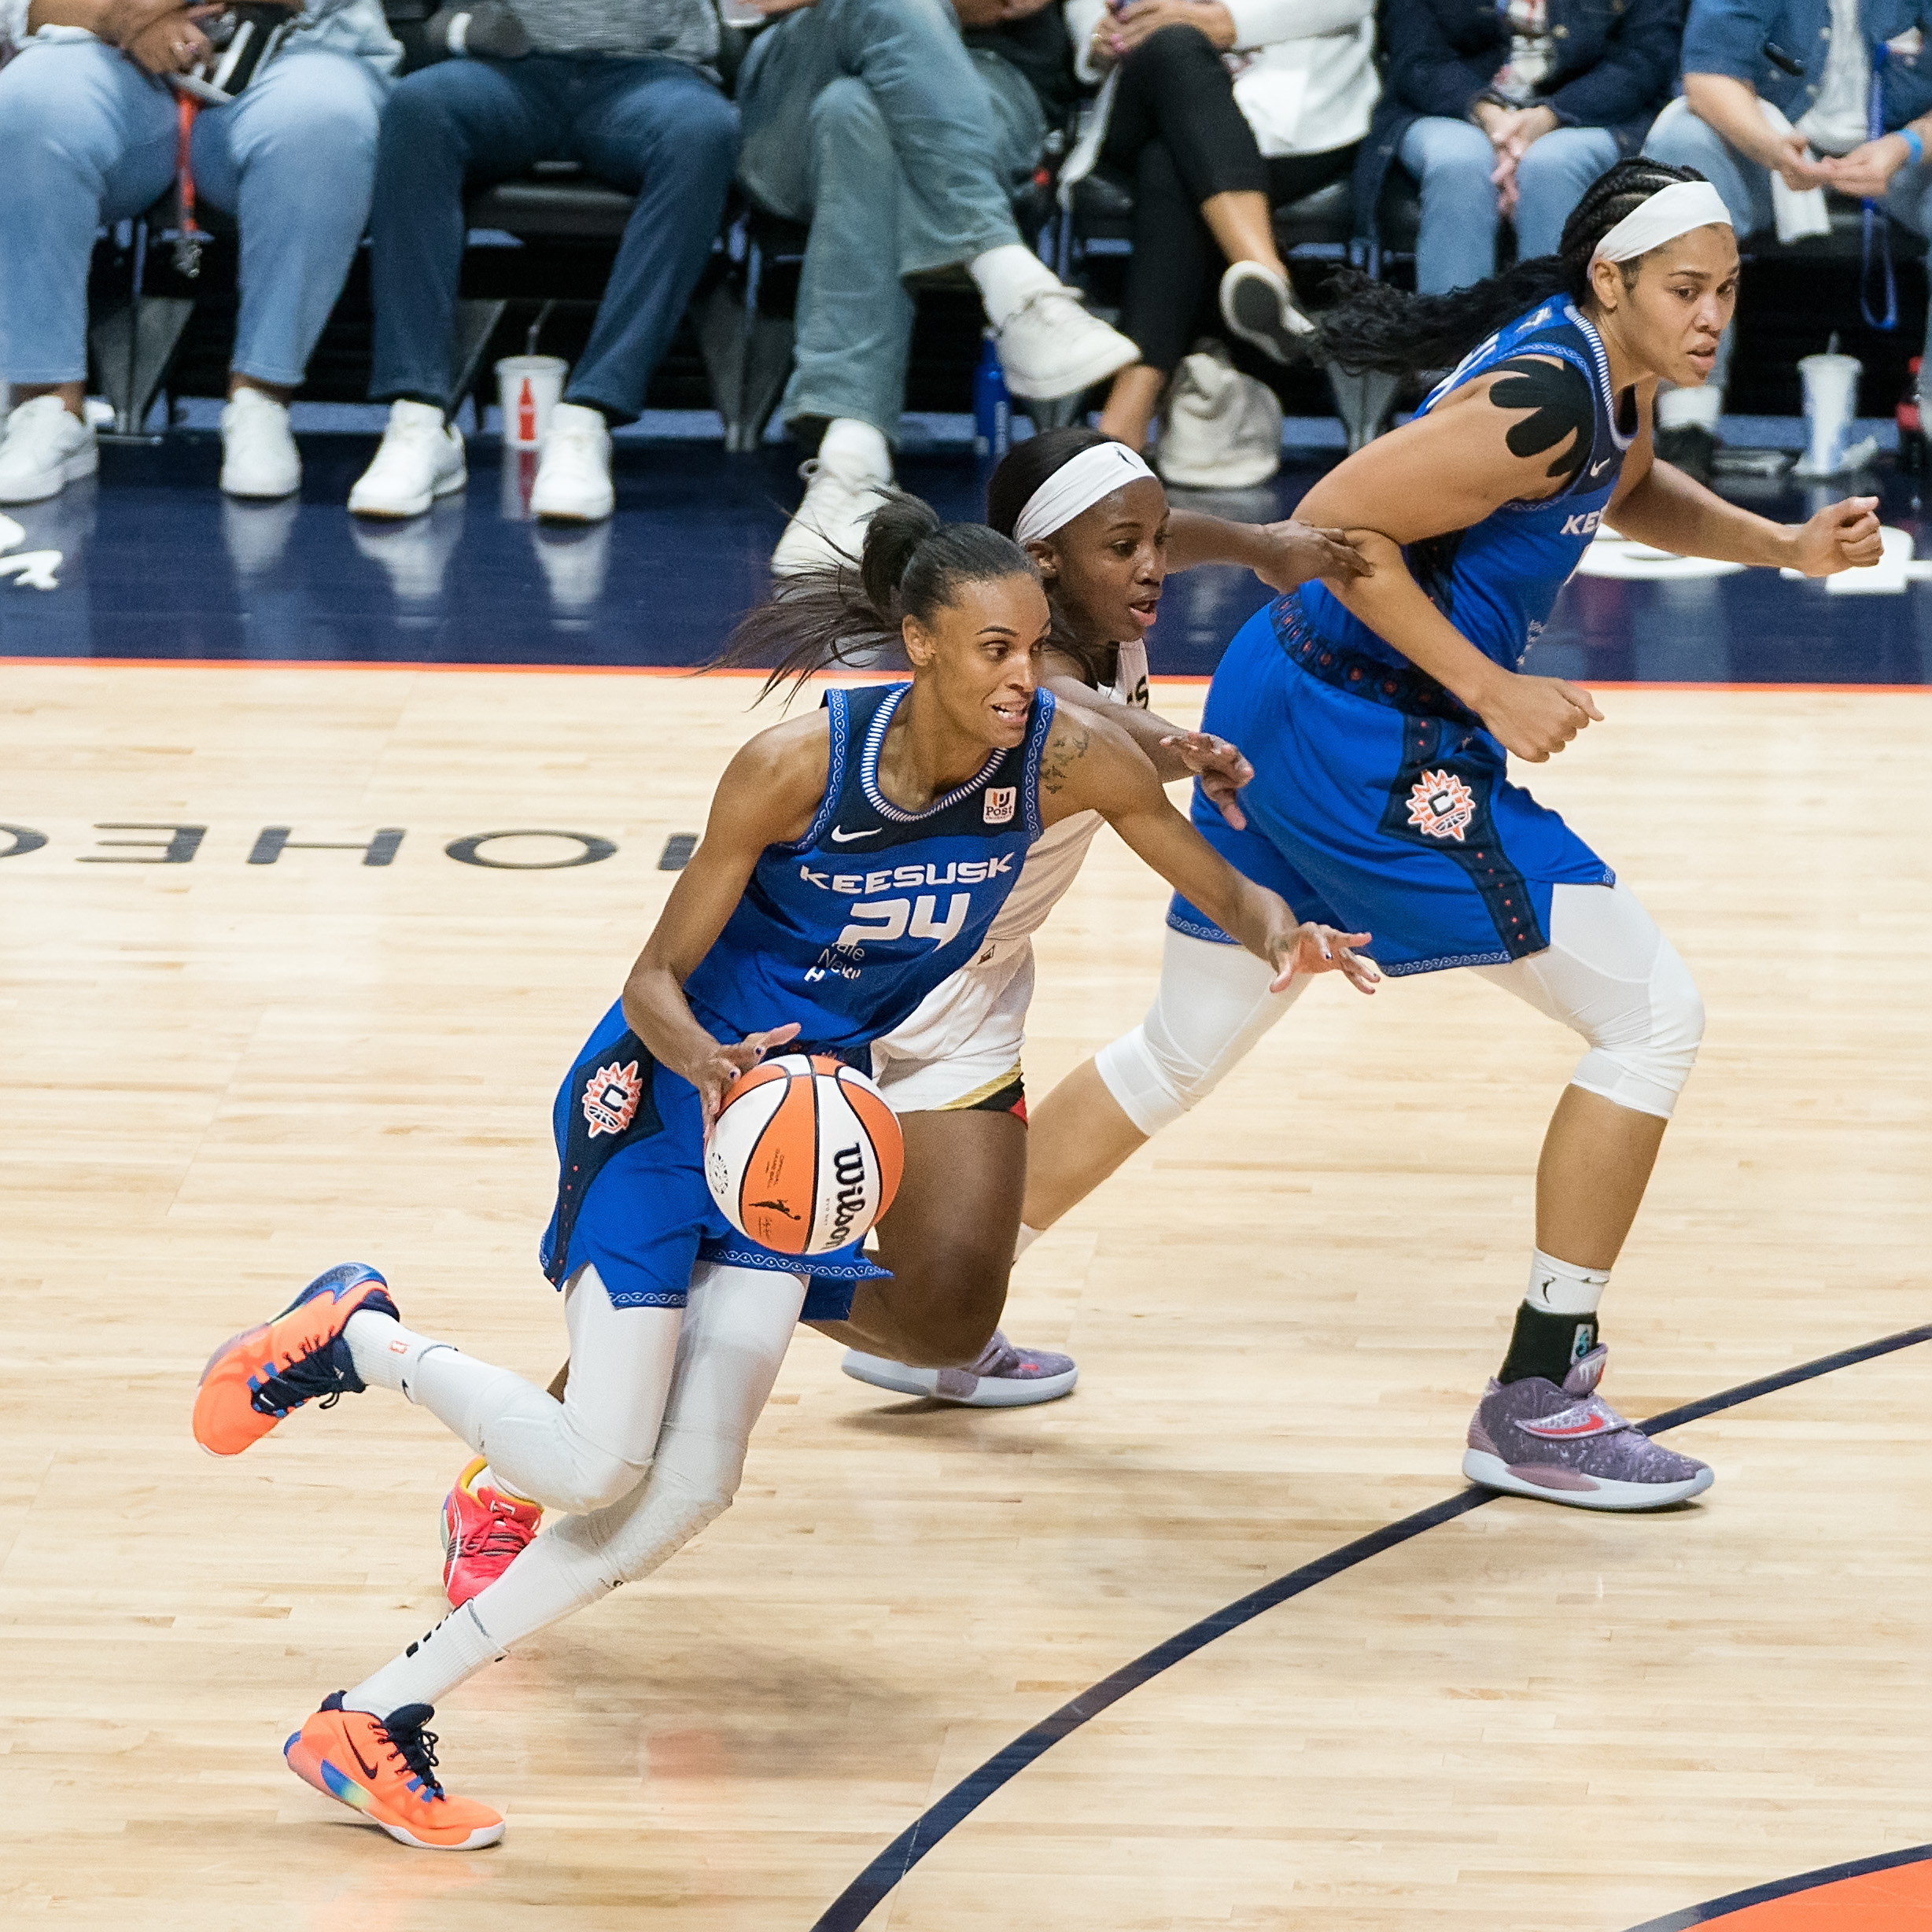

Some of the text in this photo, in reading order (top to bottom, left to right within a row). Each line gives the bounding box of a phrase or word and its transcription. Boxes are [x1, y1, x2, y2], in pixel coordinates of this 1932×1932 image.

[986, 805, 1012, 816] Post
[799, 851, 1015, 894] KEESUSK
[831, 892, 971, 953] 24
[826, 1141, 866, 1249] Wilson
